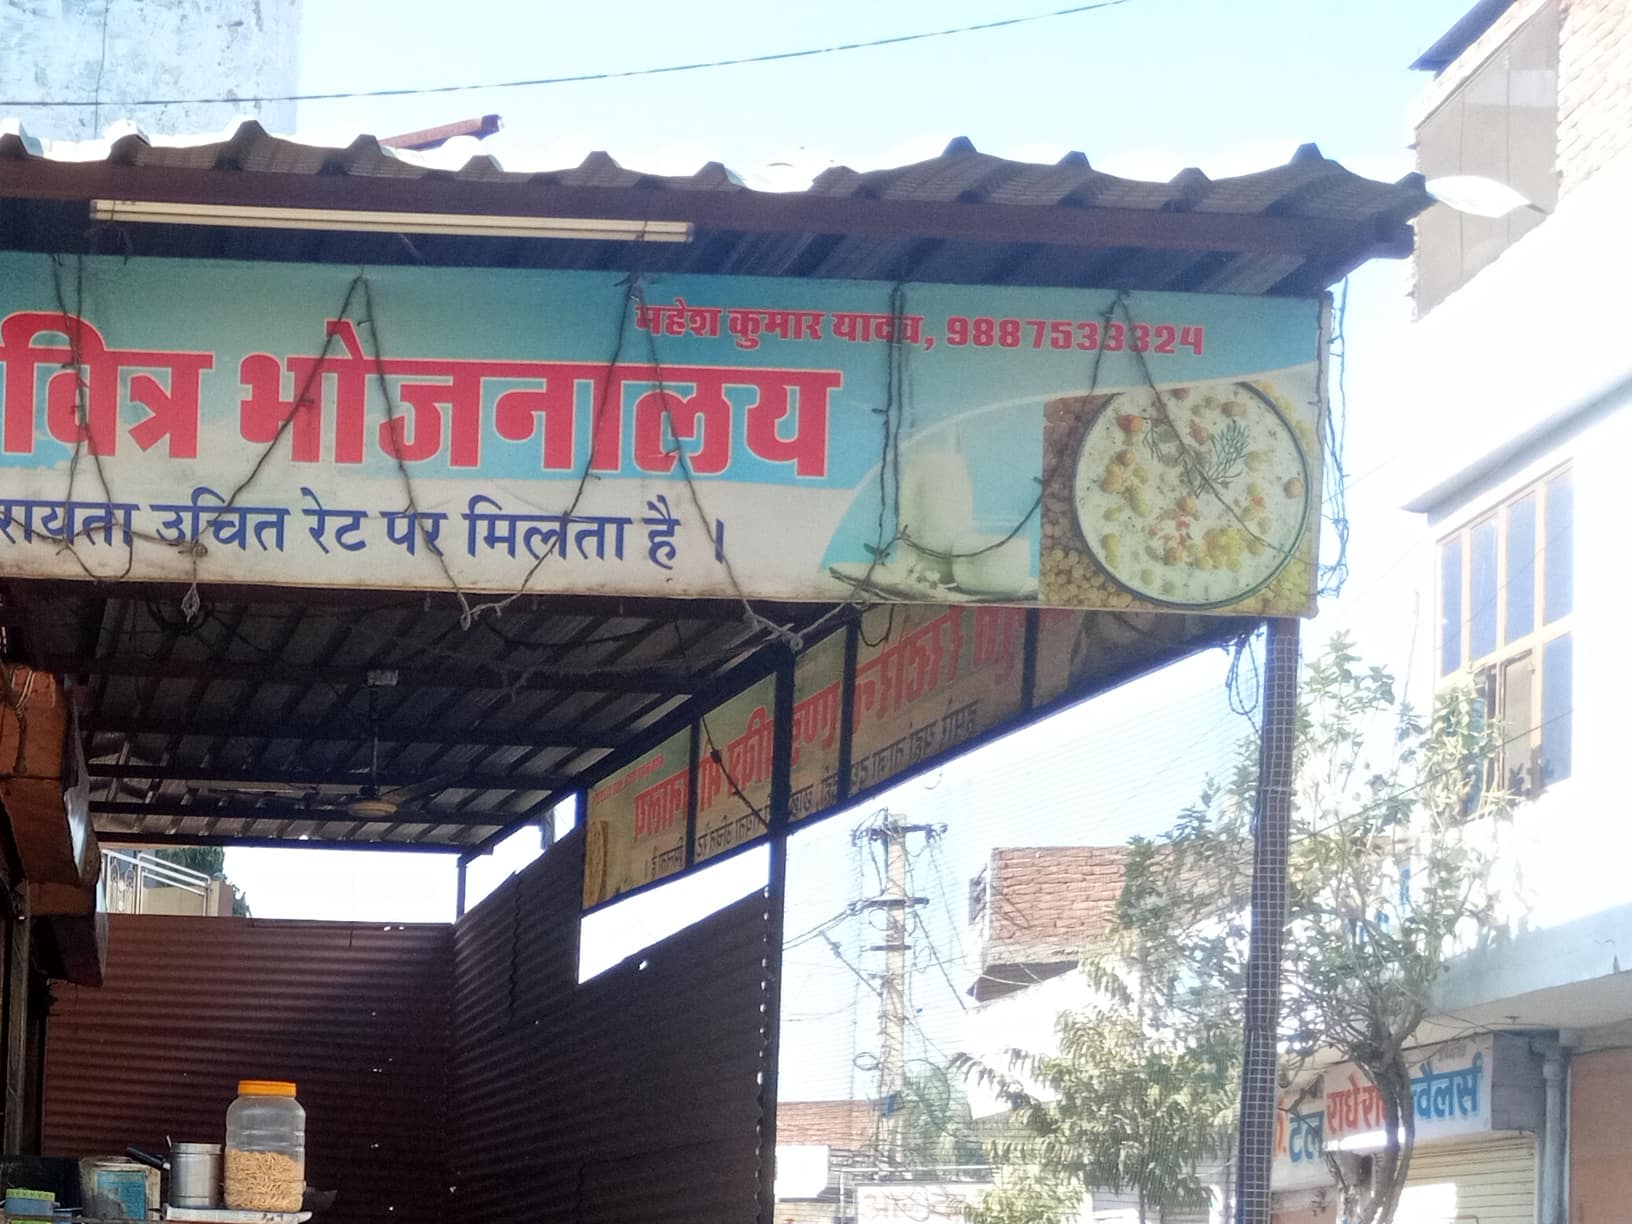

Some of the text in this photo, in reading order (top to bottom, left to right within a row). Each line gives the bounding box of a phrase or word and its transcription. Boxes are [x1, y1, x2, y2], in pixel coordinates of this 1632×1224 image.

[635, 298, 1204, 355] महेश कुमार यादव, 9887533324
[238, 320, 843, 479] भोजनालय
[150, 486, 290, 552] उचित
[302, 486, 369, 555] रेट
[384, 511, 448, 557] पर
[462, 495, 632, 561] मिलता
[642, 495, 681, 569] है
